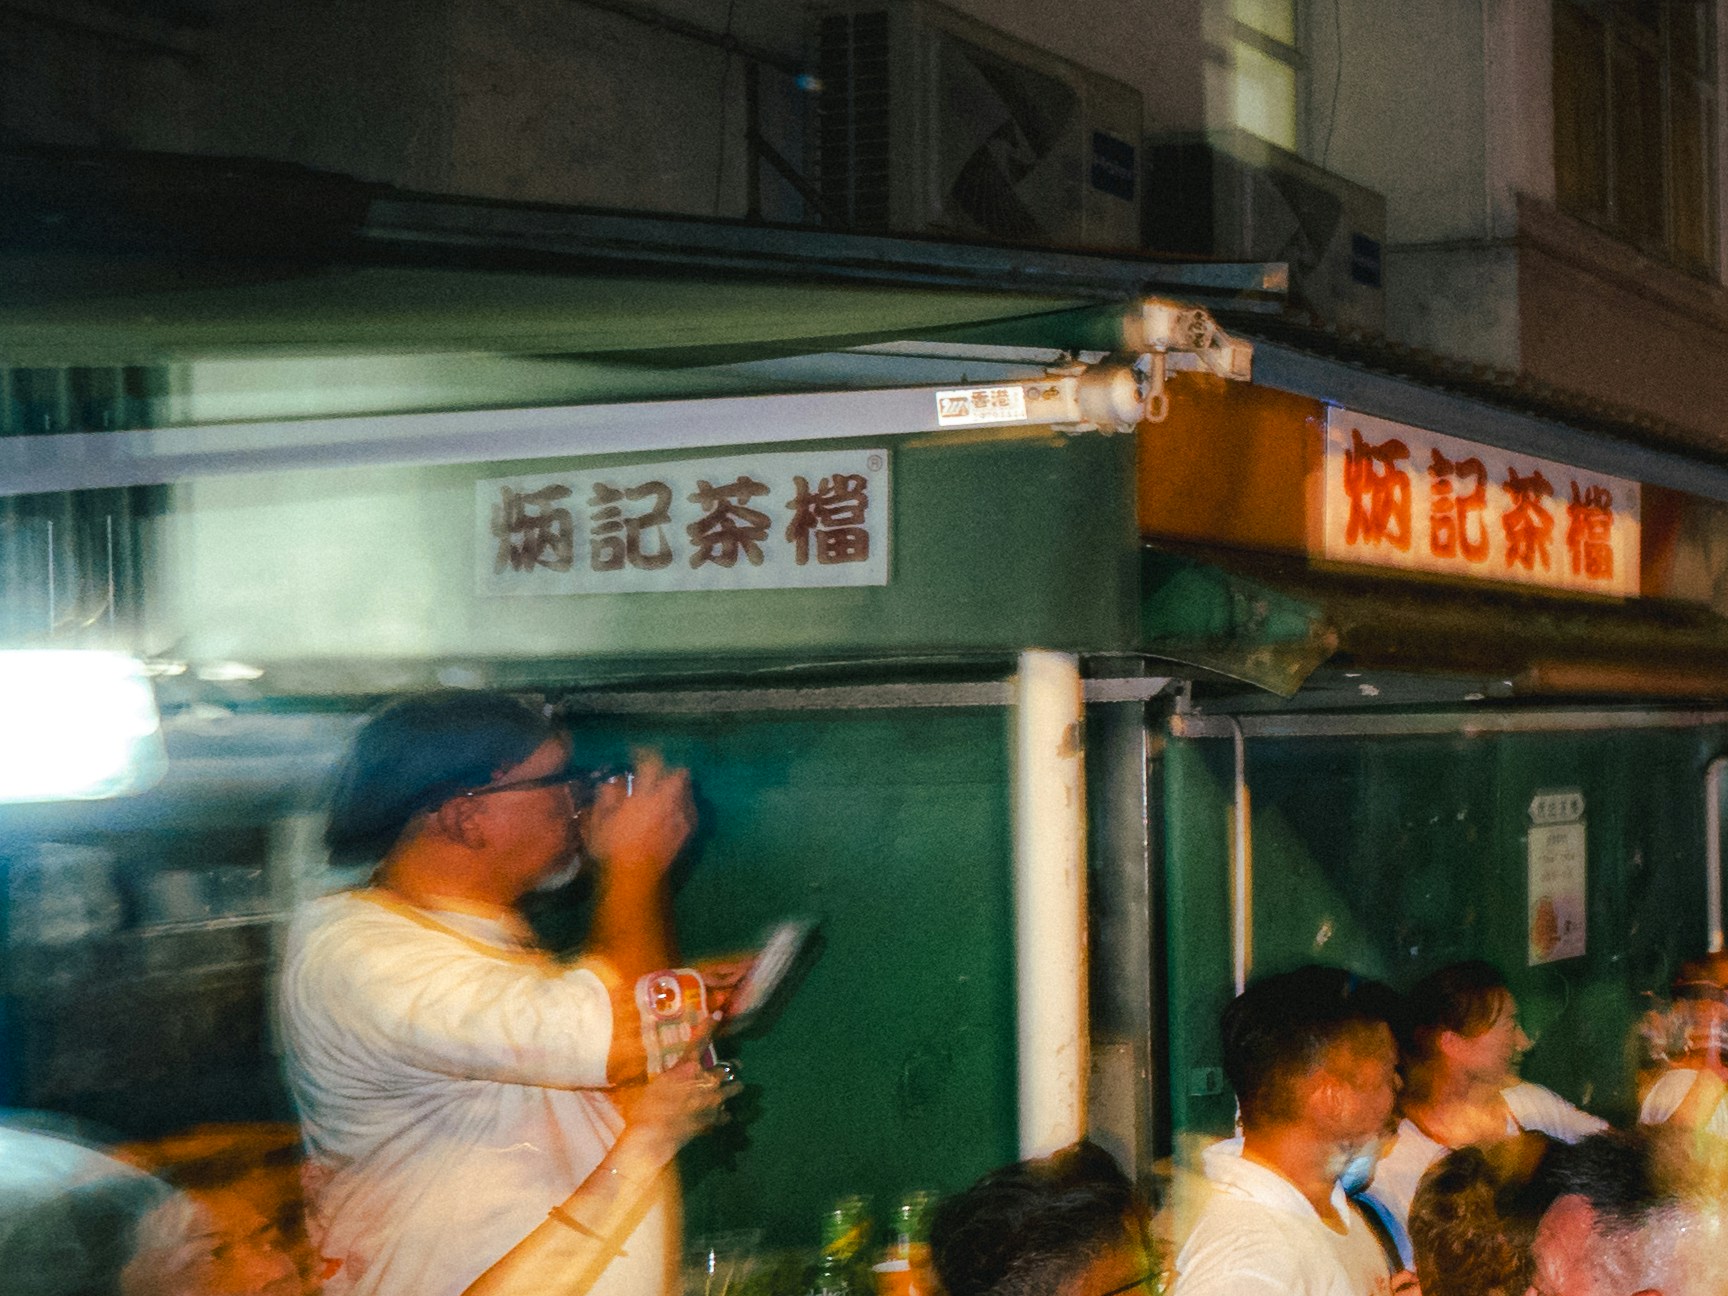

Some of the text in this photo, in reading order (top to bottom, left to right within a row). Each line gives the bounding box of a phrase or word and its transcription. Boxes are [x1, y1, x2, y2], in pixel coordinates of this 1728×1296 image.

[490, 473, 870, 574] 炳記茶檔
[1343, 428, 1614, 580] 炳記茶檔
